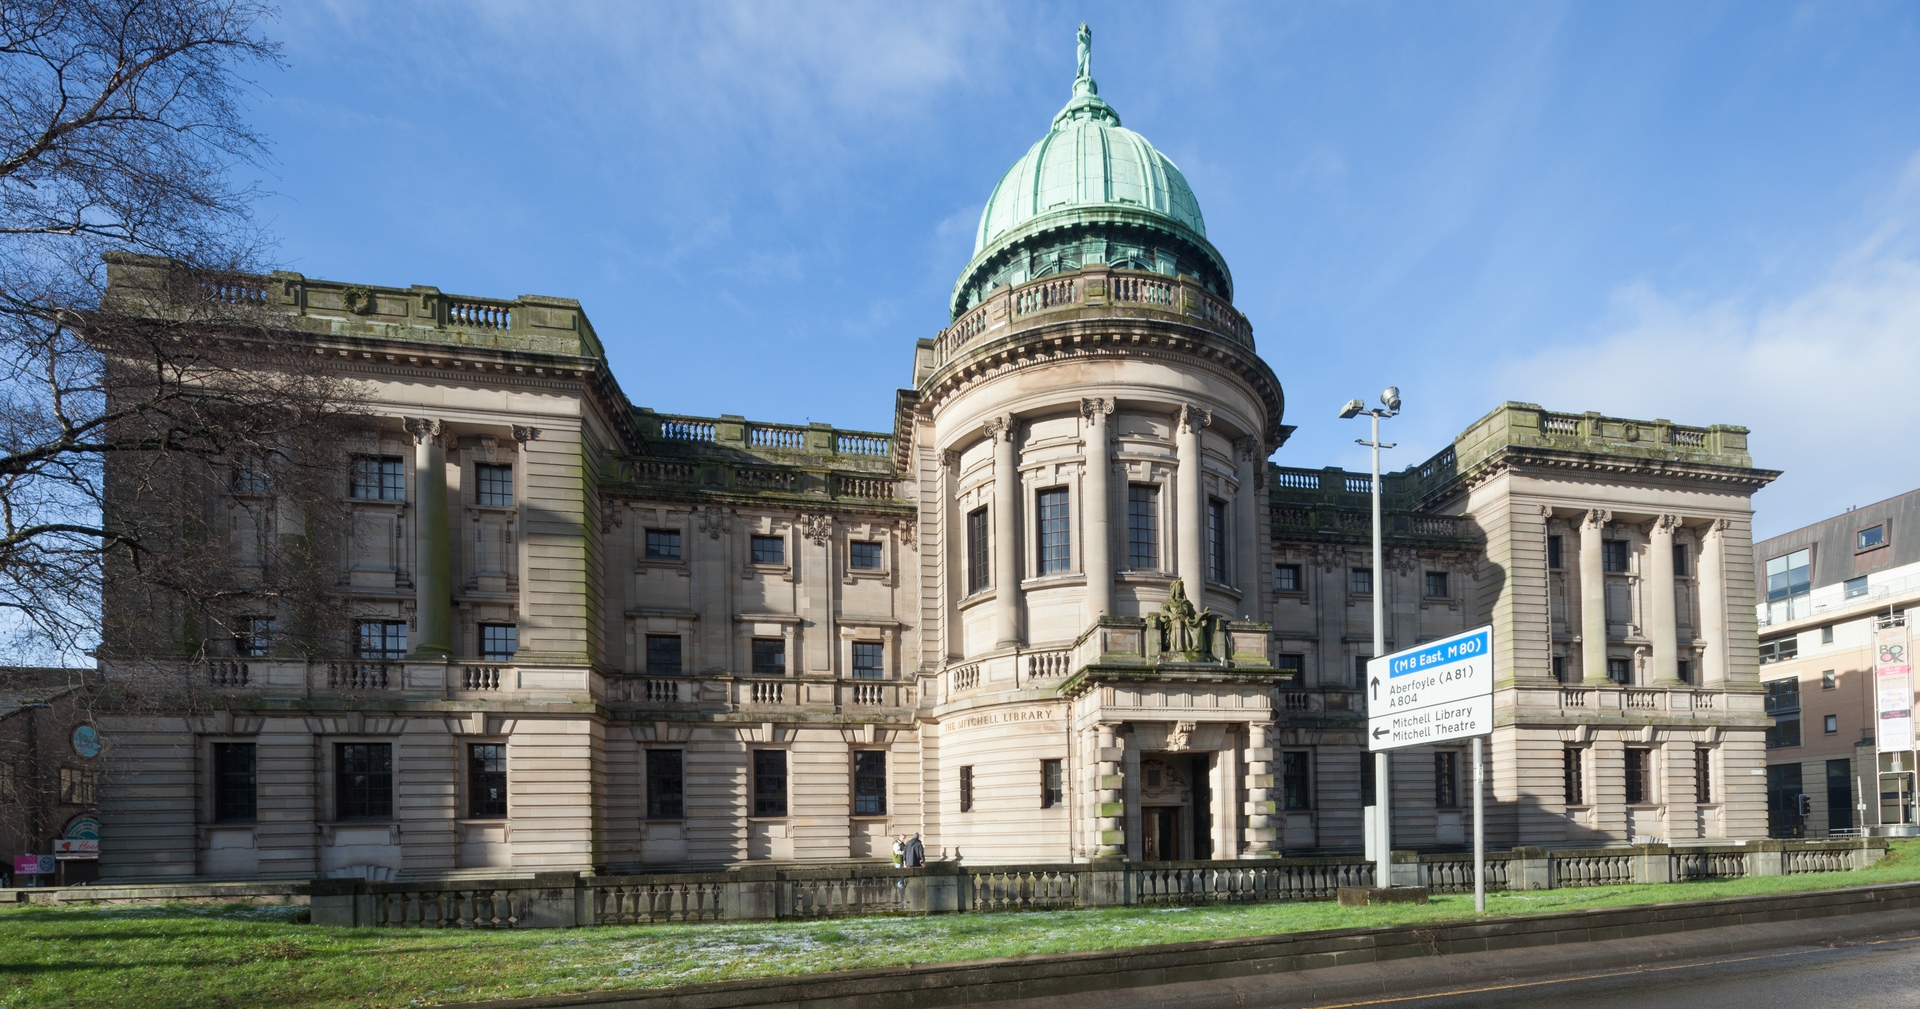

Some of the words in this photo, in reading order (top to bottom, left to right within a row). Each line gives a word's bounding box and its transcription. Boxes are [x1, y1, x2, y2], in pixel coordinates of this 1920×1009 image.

[1419, 650, 1444, 666] East,
[1389, 676, 1436, 696] Aberfoyle
[1389, 693, 1418, 708] A804
[944, 722, 956, 732] THE
[957, 715, 999, 729] MITCHELL
[1003, 710, 1052, 722] LIBRARY
[1393, 713, 1431, 729] Mitchell
[1435, 706, 1473, 721] Library
[1393, 726, 1431, 742] Mitchell
[1435, 720, 1476, 735] Theatre
